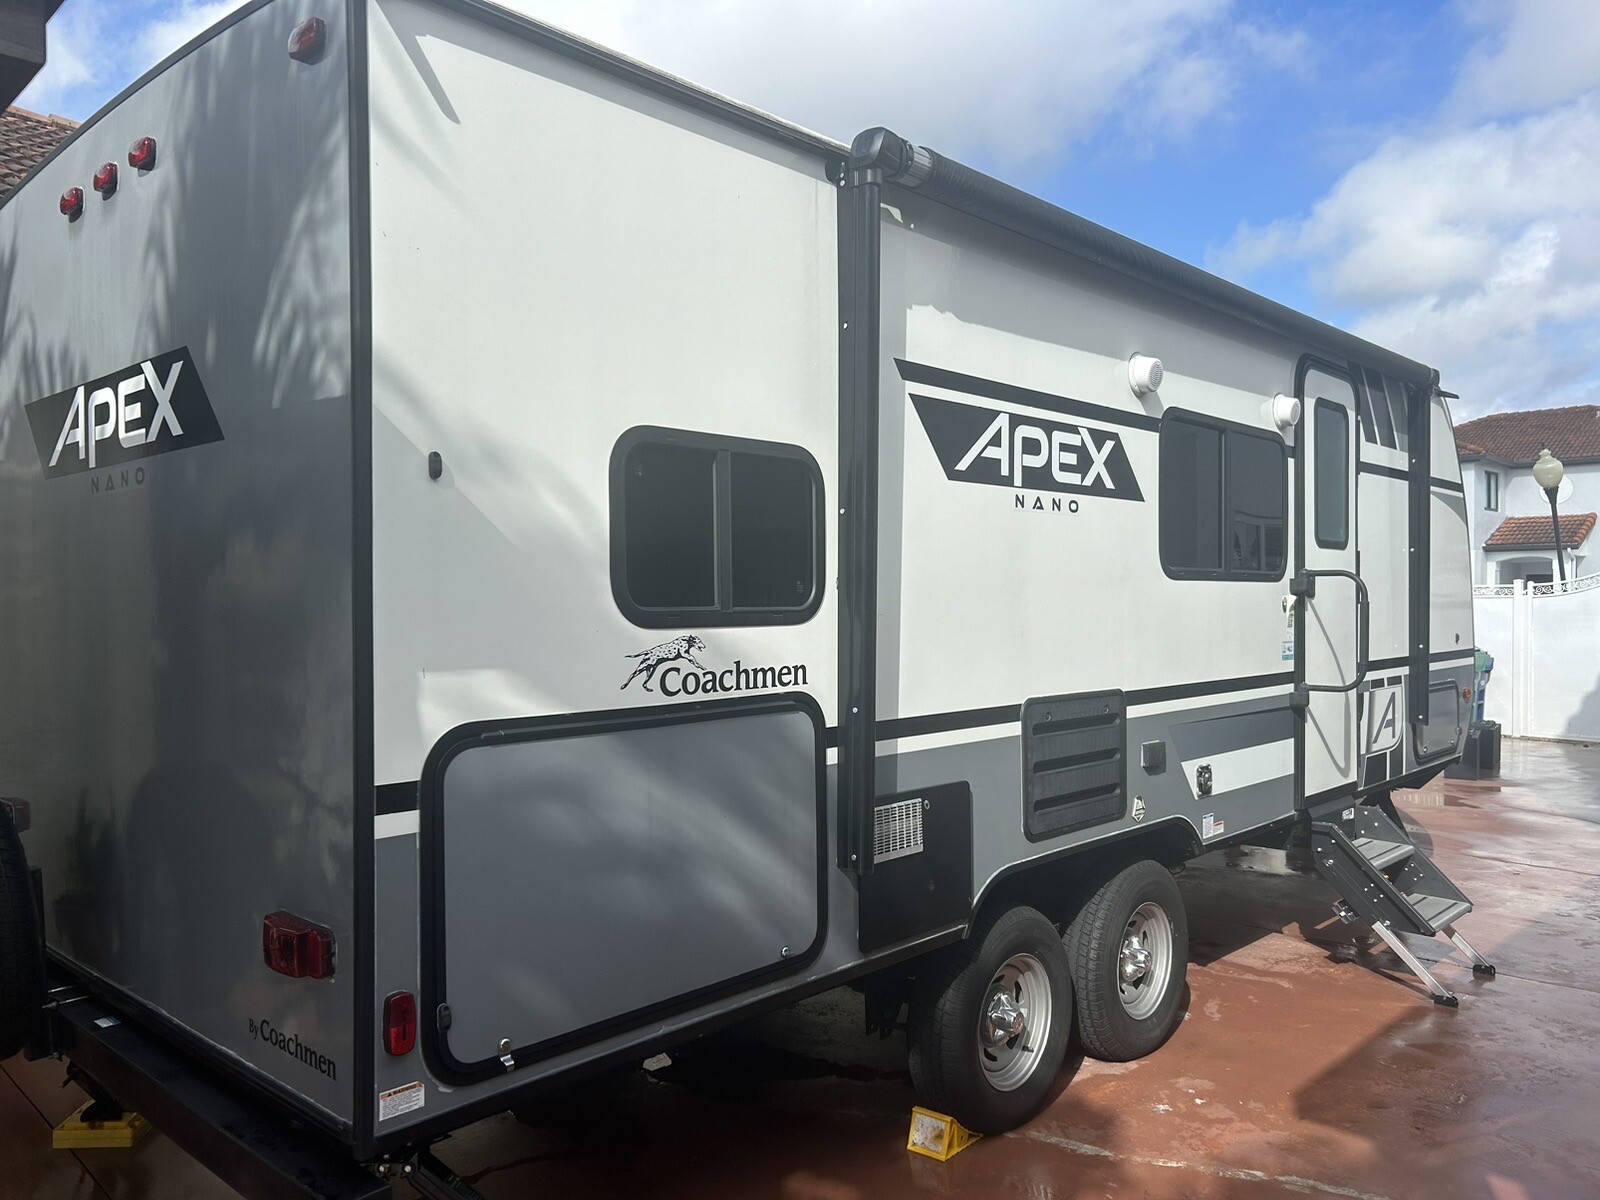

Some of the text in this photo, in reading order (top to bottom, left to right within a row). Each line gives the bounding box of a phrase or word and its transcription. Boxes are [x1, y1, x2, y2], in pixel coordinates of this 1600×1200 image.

[48, 360, 184, 469] APEX
[954, 412, 1116, 490] APEX
[91, 466, 145, 494] NANO
[1015, 493, 1079, 514] NANO
[659, 660, 808, 697] Coachmen
[1372, 690, 1396, 744] A
[248, 1018, 337, 1081] By Coachmen
